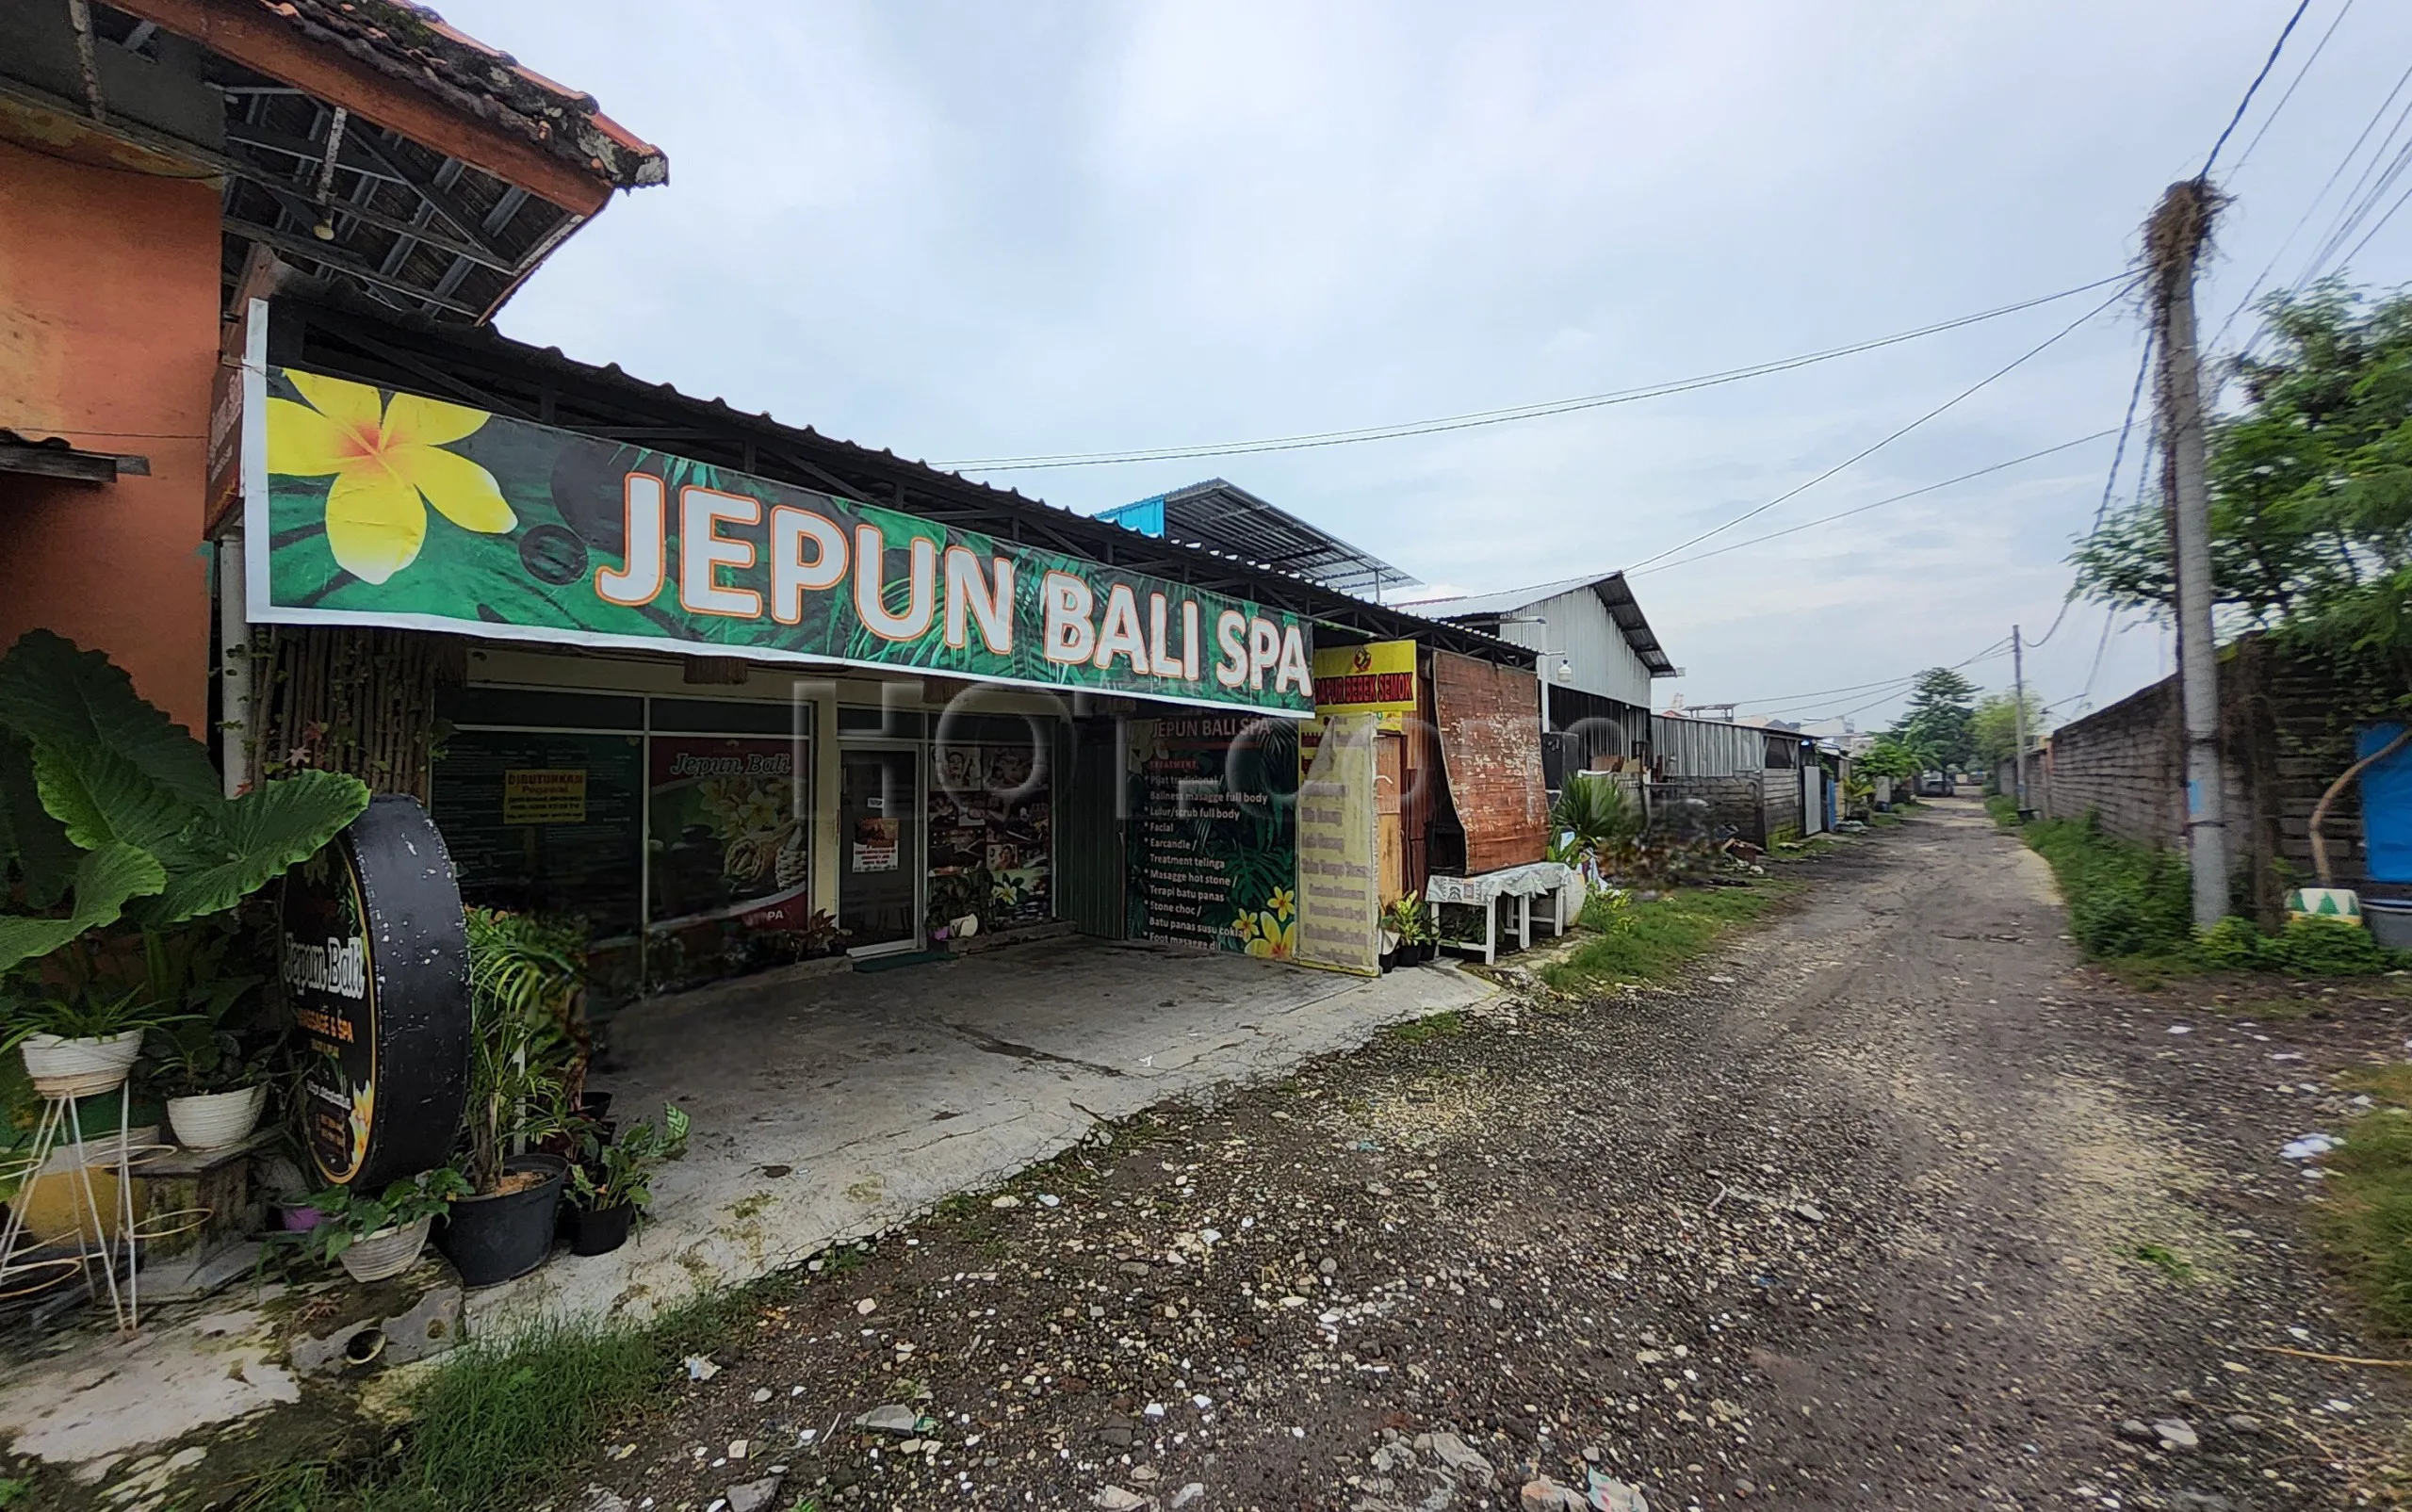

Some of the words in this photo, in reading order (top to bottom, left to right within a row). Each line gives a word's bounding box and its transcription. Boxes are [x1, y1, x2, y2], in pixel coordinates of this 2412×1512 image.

[595, 471, 1013, 656] JEPUN
[1043, 569, 1199, 681] BALI
[1216, 609, 1313, 697] SPA
[1314, 675, 1345, 706] DAPUR
[1345, 674, 1377, 704] BEBEK
[1377, 672, 1413, 703] SEMOK
[1151, 718, 1198, 739] JEPUN
[1201, 717, 1236, 737] BALI
[1239, 716, 1271, 736] SPA
[670, 753, 742, 779] Jepun
[745, 754, 791, 775] Bali
[1149, 775, 1169, 786] Pijat
[1170, 774, 1218, 786] tradisional
[1226, 791, 1242, 802] full
[1244, 791, 1268, 805] body
[1199, 807, 1215, 819] full
[1216, 807, 1241, 821] body
[1149, 822, 1174, 833] Facial
[1149, 837, 1191, 850] Earcandle
[1149, 854, 1193, 867] Treatment
[1194, 858, 1225, 870] telinga
[1149, 869, 1187, 883] Masagge
[1188, 872, 1204, 884] hot
[1205, 875, 1231, 886] stone
[1149, 885, 1175, 897] Terapi
[1177, 886, 1197, 899] batu
[1198, 892, 1225, 902] panas
[1149, 900, 1174, 913] Stone
[1175, 903, 1196, 915] choc
[1149, 917, 1168, 927] Batu
[1169, 920, 1196, 932] panas
[1197, 924, 1217, 935] susu
[1218, 926, 1245, 938] cokla
[1149, 932, 1168, 943] Foot
[285, 933, 328, 995] Jepun
[327, 936, 366, 1000] Bali
